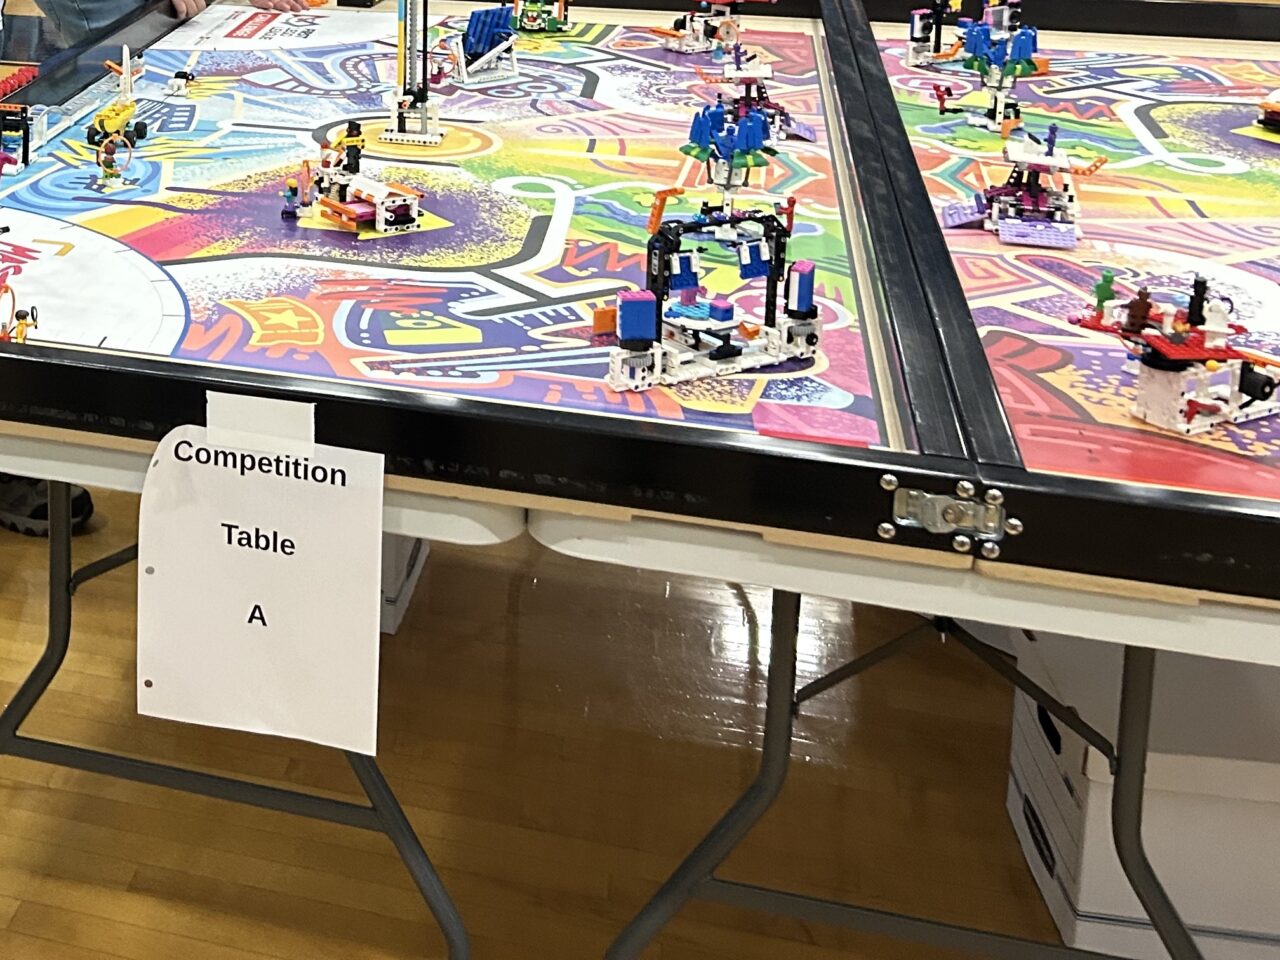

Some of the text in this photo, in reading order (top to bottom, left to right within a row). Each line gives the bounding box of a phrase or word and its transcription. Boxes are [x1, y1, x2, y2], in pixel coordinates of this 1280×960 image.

[174, 440, 347, 487] Competition
[221, 523, 296, 556] Table
[247, 604, 268, 627] A
